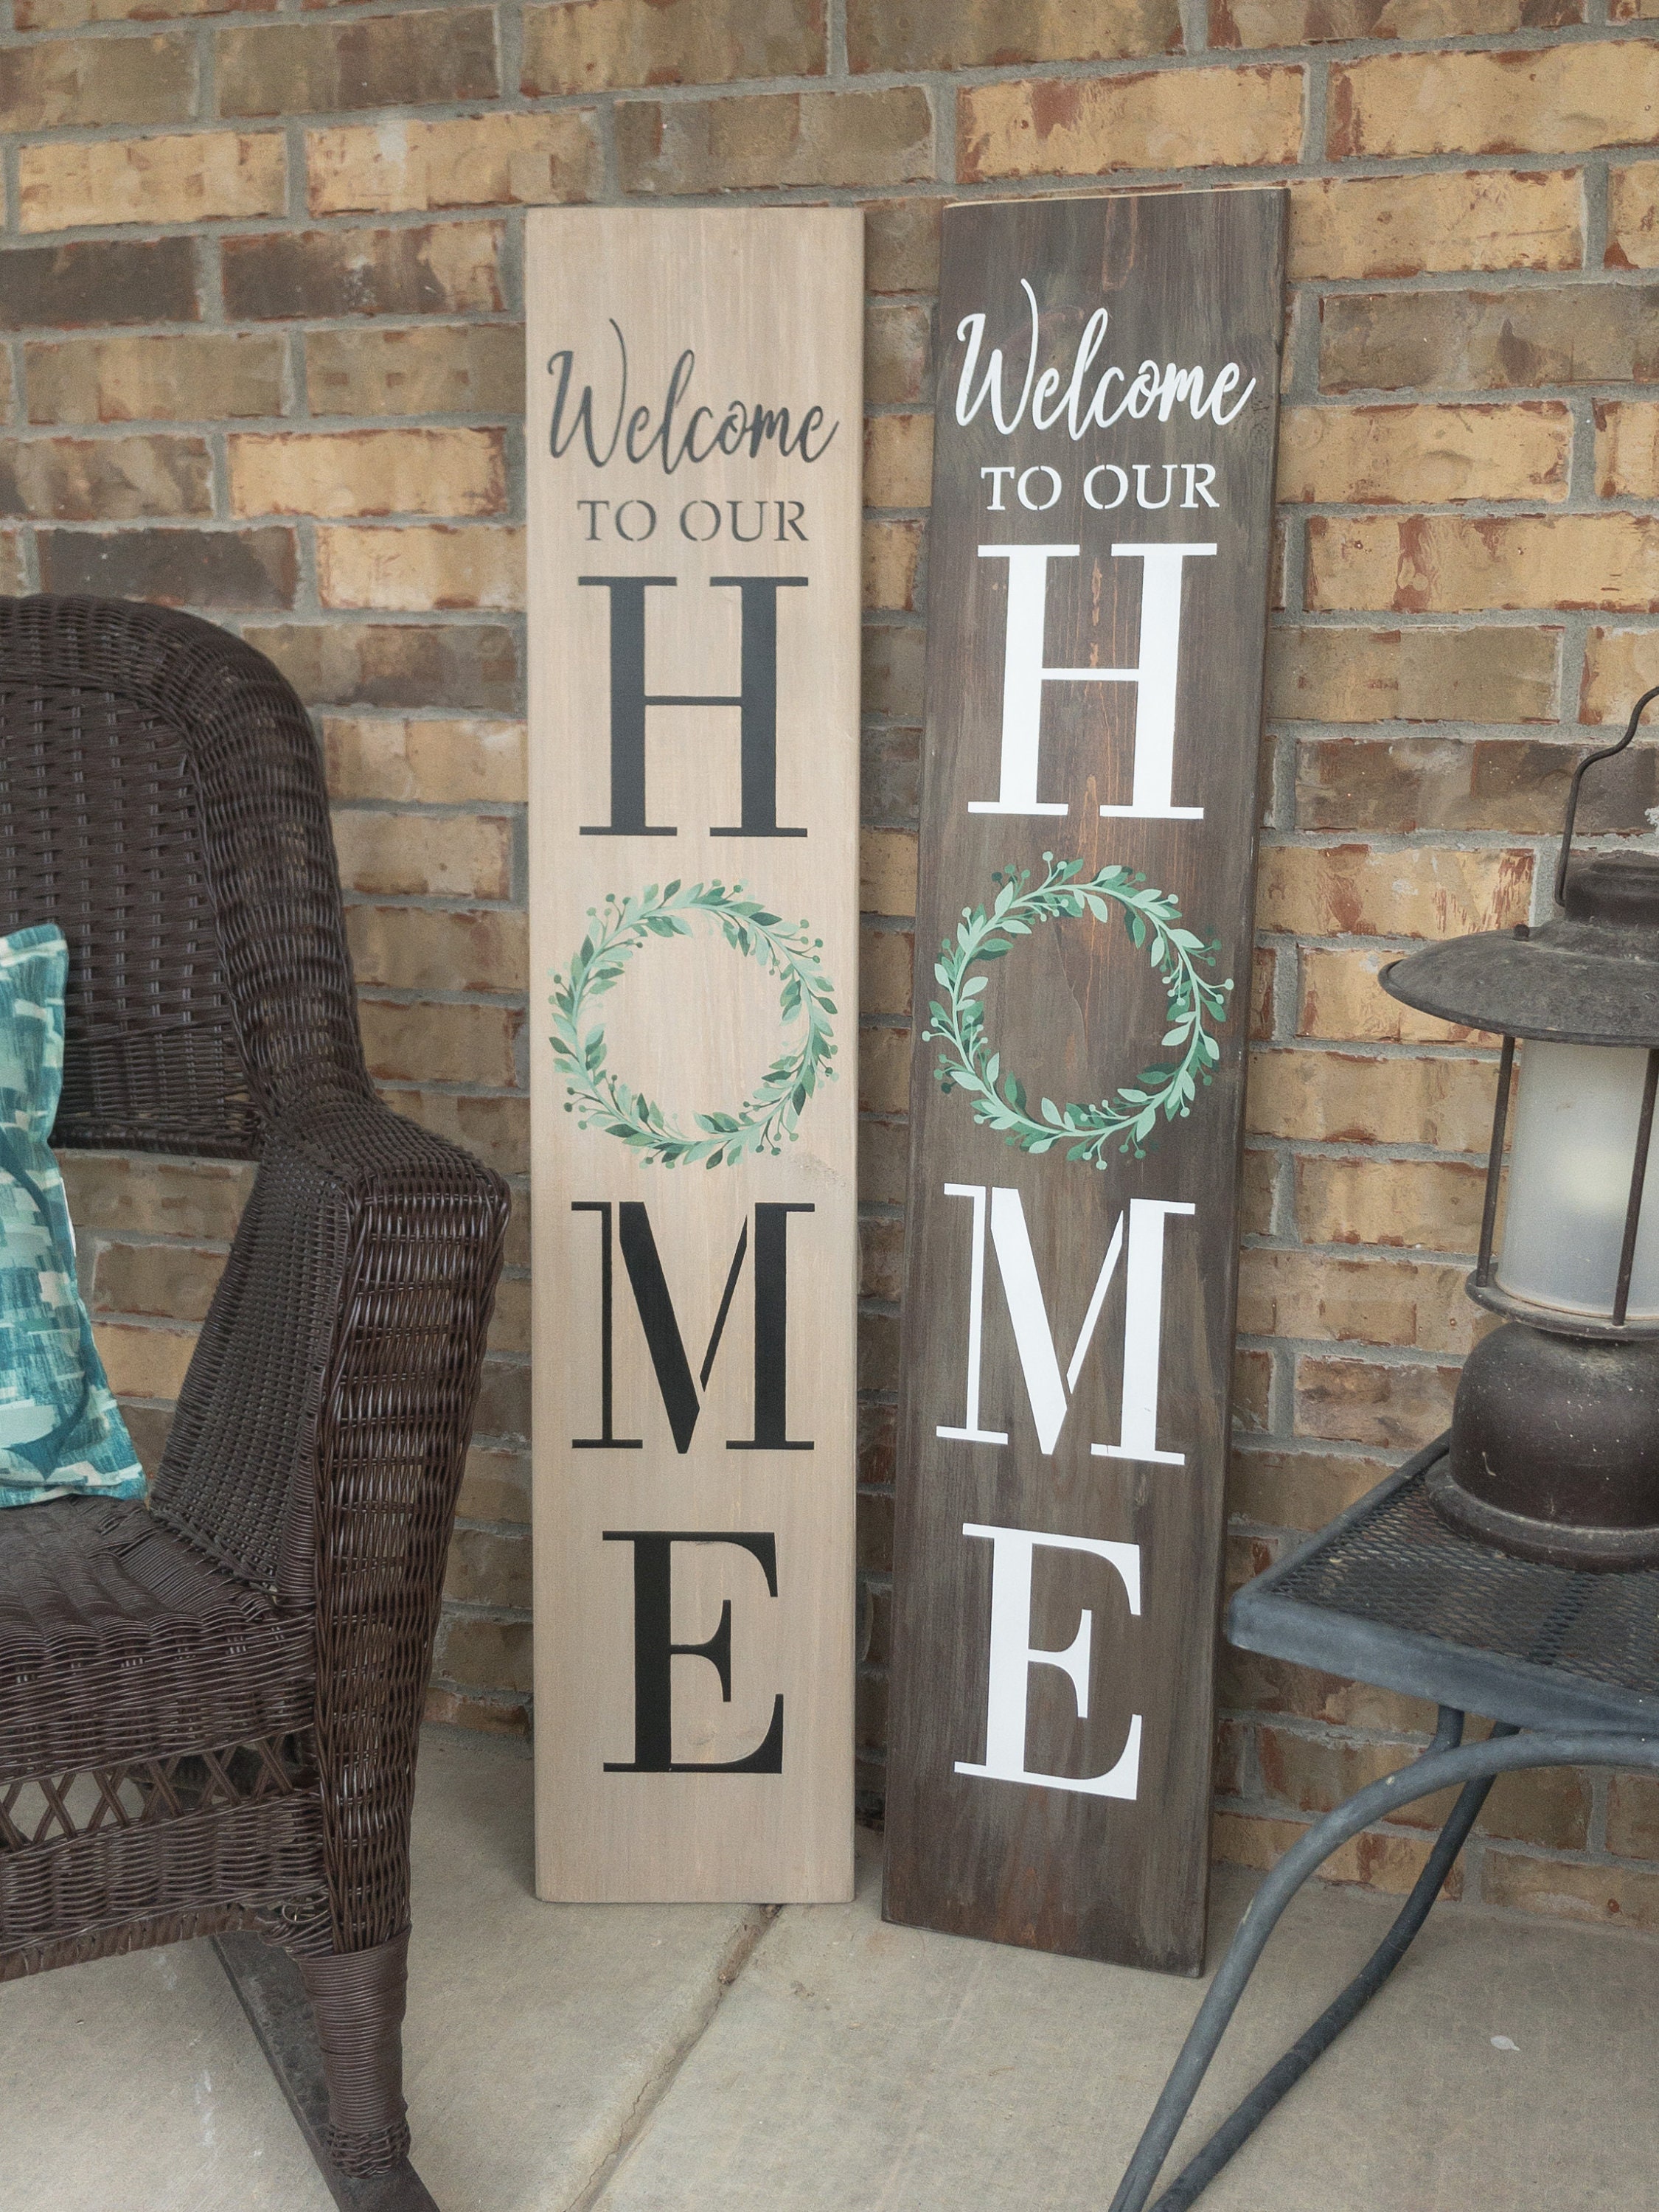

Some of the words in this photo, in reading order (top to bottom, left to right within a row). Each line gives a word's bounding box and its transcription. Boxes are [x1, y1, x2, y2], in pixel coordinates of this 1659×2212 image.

[547, 319, 839, 475] Welcome
[956, 278, 1257, 441] Welcome
[577, 499, 657, 542] TO
[679, 499, 809, 543] OUR
[981, 465, 1062, 511] TO
[1082, 463, 1220, 510] OUR
